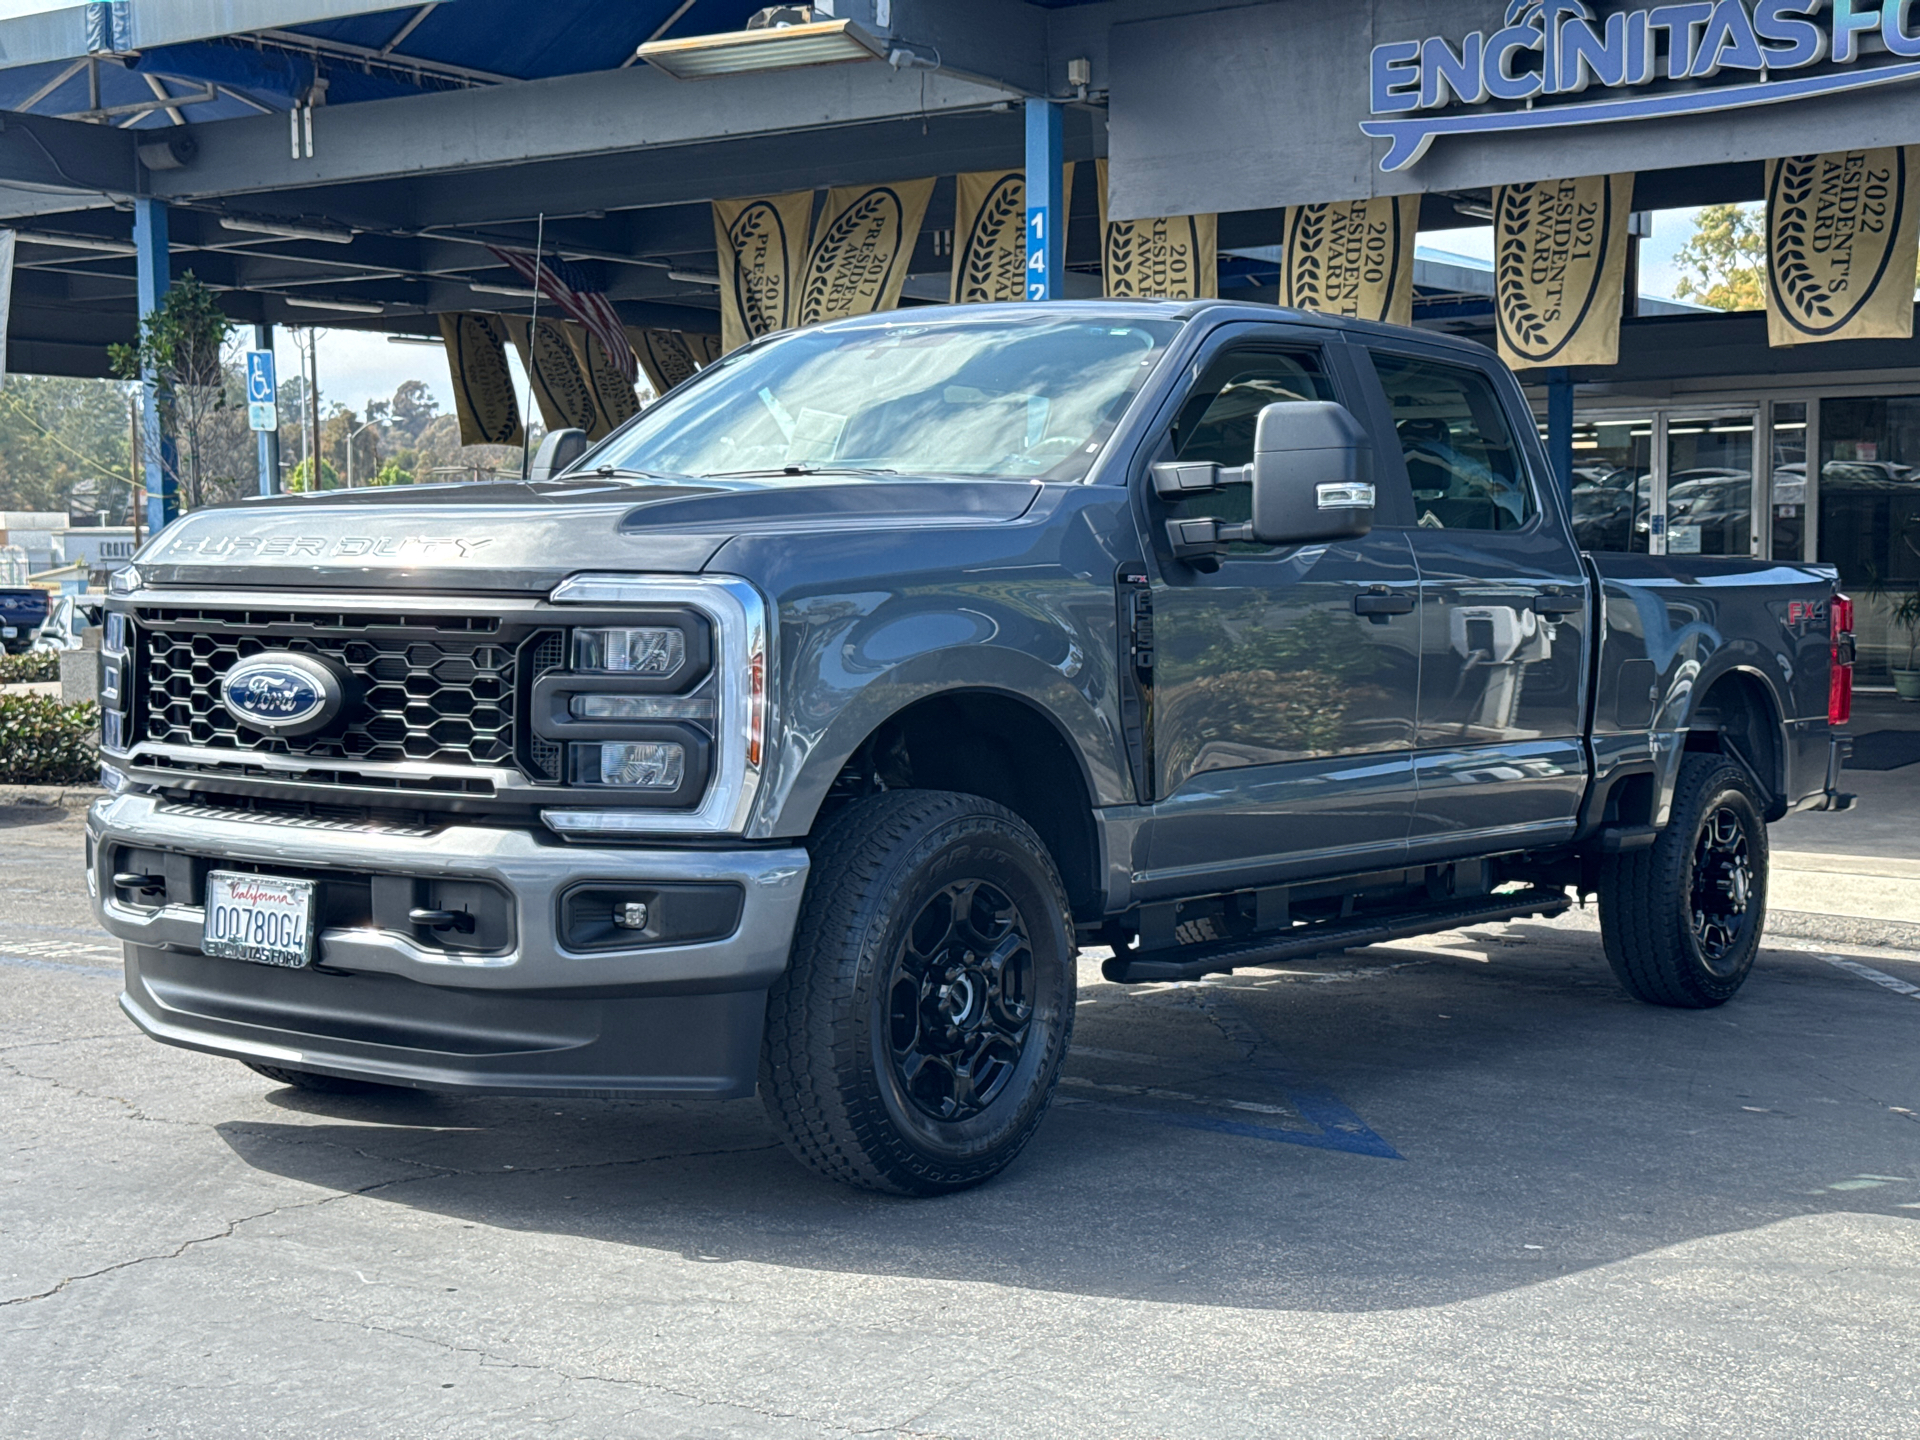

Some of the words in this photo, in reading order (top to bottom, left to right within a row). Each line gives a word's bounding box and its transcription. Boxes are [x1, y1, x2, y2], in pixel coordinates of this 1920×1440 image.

[1369, 0, 1827, 114] ENCINITAS
[1813, 160, 1843, 253] AWARD
[1828, 151, 1866, 293] ESIDENT'S
[1859, 169, 1890, 233] 2022
[1325, 210, 1348, 302] AWARD
[1363, 221, 1387, 283] 2020
[1530, 191, 1555, 285] AWARD
[1571, 202, 1598, 262] 2021
[765, 275, 780, 328] 2016
[826, 243, 859, 312] AWARD
[859, 254, 888, 297] 2017
[595, 369, 611, 399] 2021
[169, 536, 328, 557] SUPER
[331, 535, 495, 559] DUTY
[1788, 601, 1826, 625] FX4
[244, 675, 299, 712] Ford
[231, 882, 295, 907] California
[215, 905, 304, 950] 00780G4
